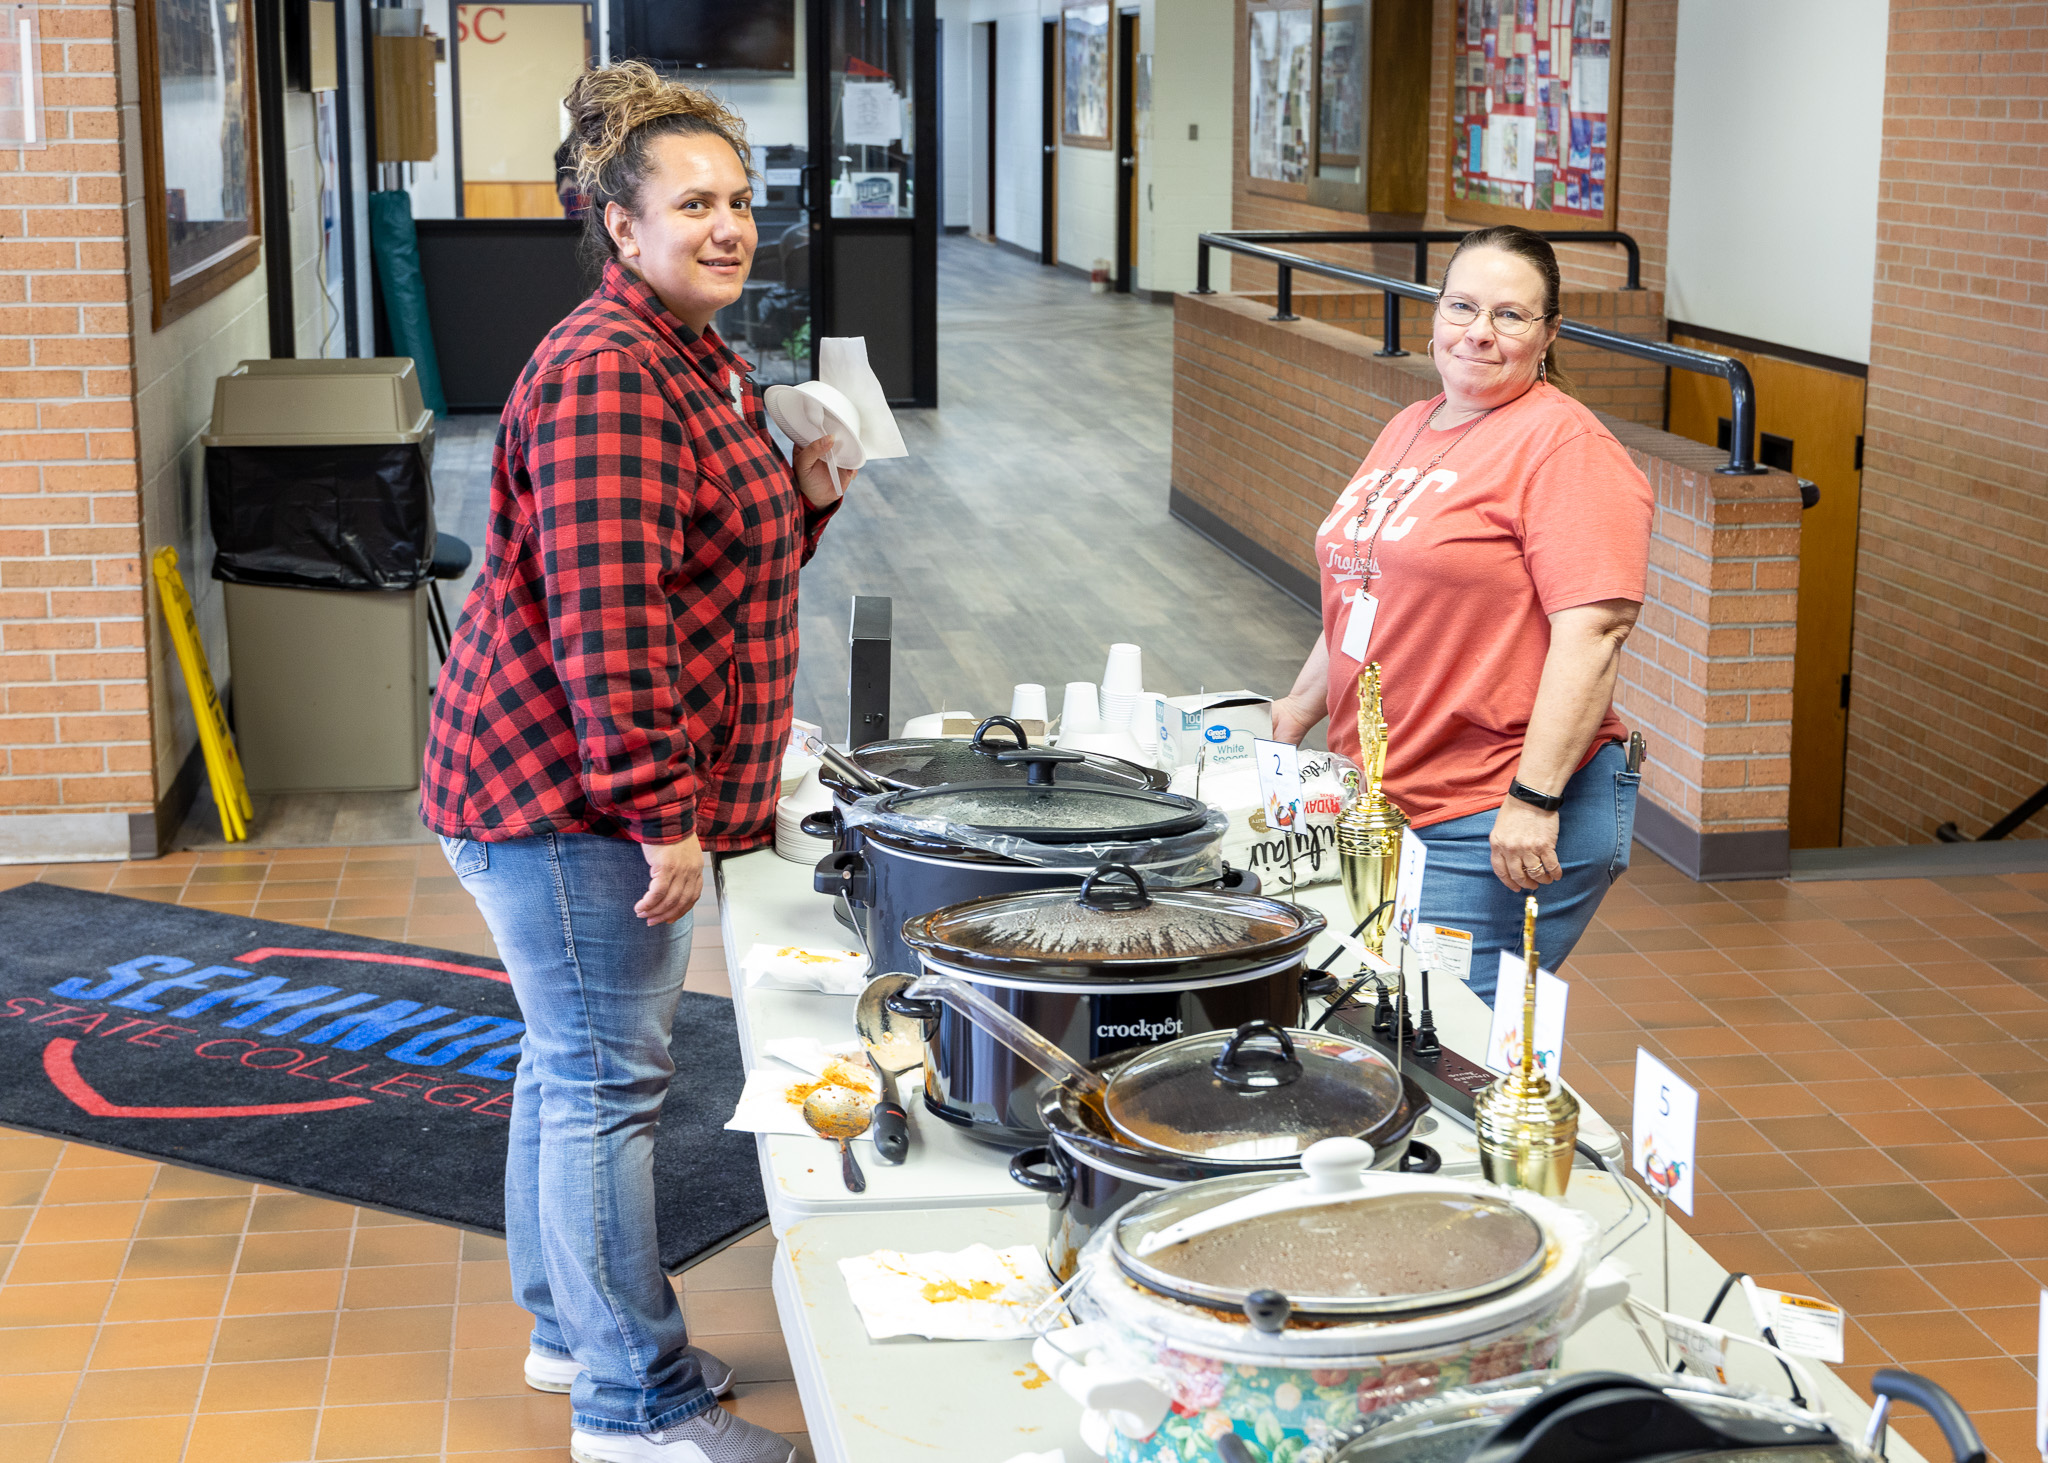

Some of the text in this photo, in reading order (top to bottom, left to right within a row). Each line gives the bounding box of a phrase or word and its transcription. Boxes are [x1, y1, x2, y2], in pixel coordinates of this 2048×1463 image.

[1184, 714, 1201, 724] 100
[1217, 744, 1245, 754] White
[1273, 753, 1283, 776] 2
[50, 955, 527, 1081] SEMINOL
[1096, 1017, 1184, 1041] crockpot
[0, 997, 514, 1118] STATE COLLEGE
[1658, 1085, 1671, 1117] 5
